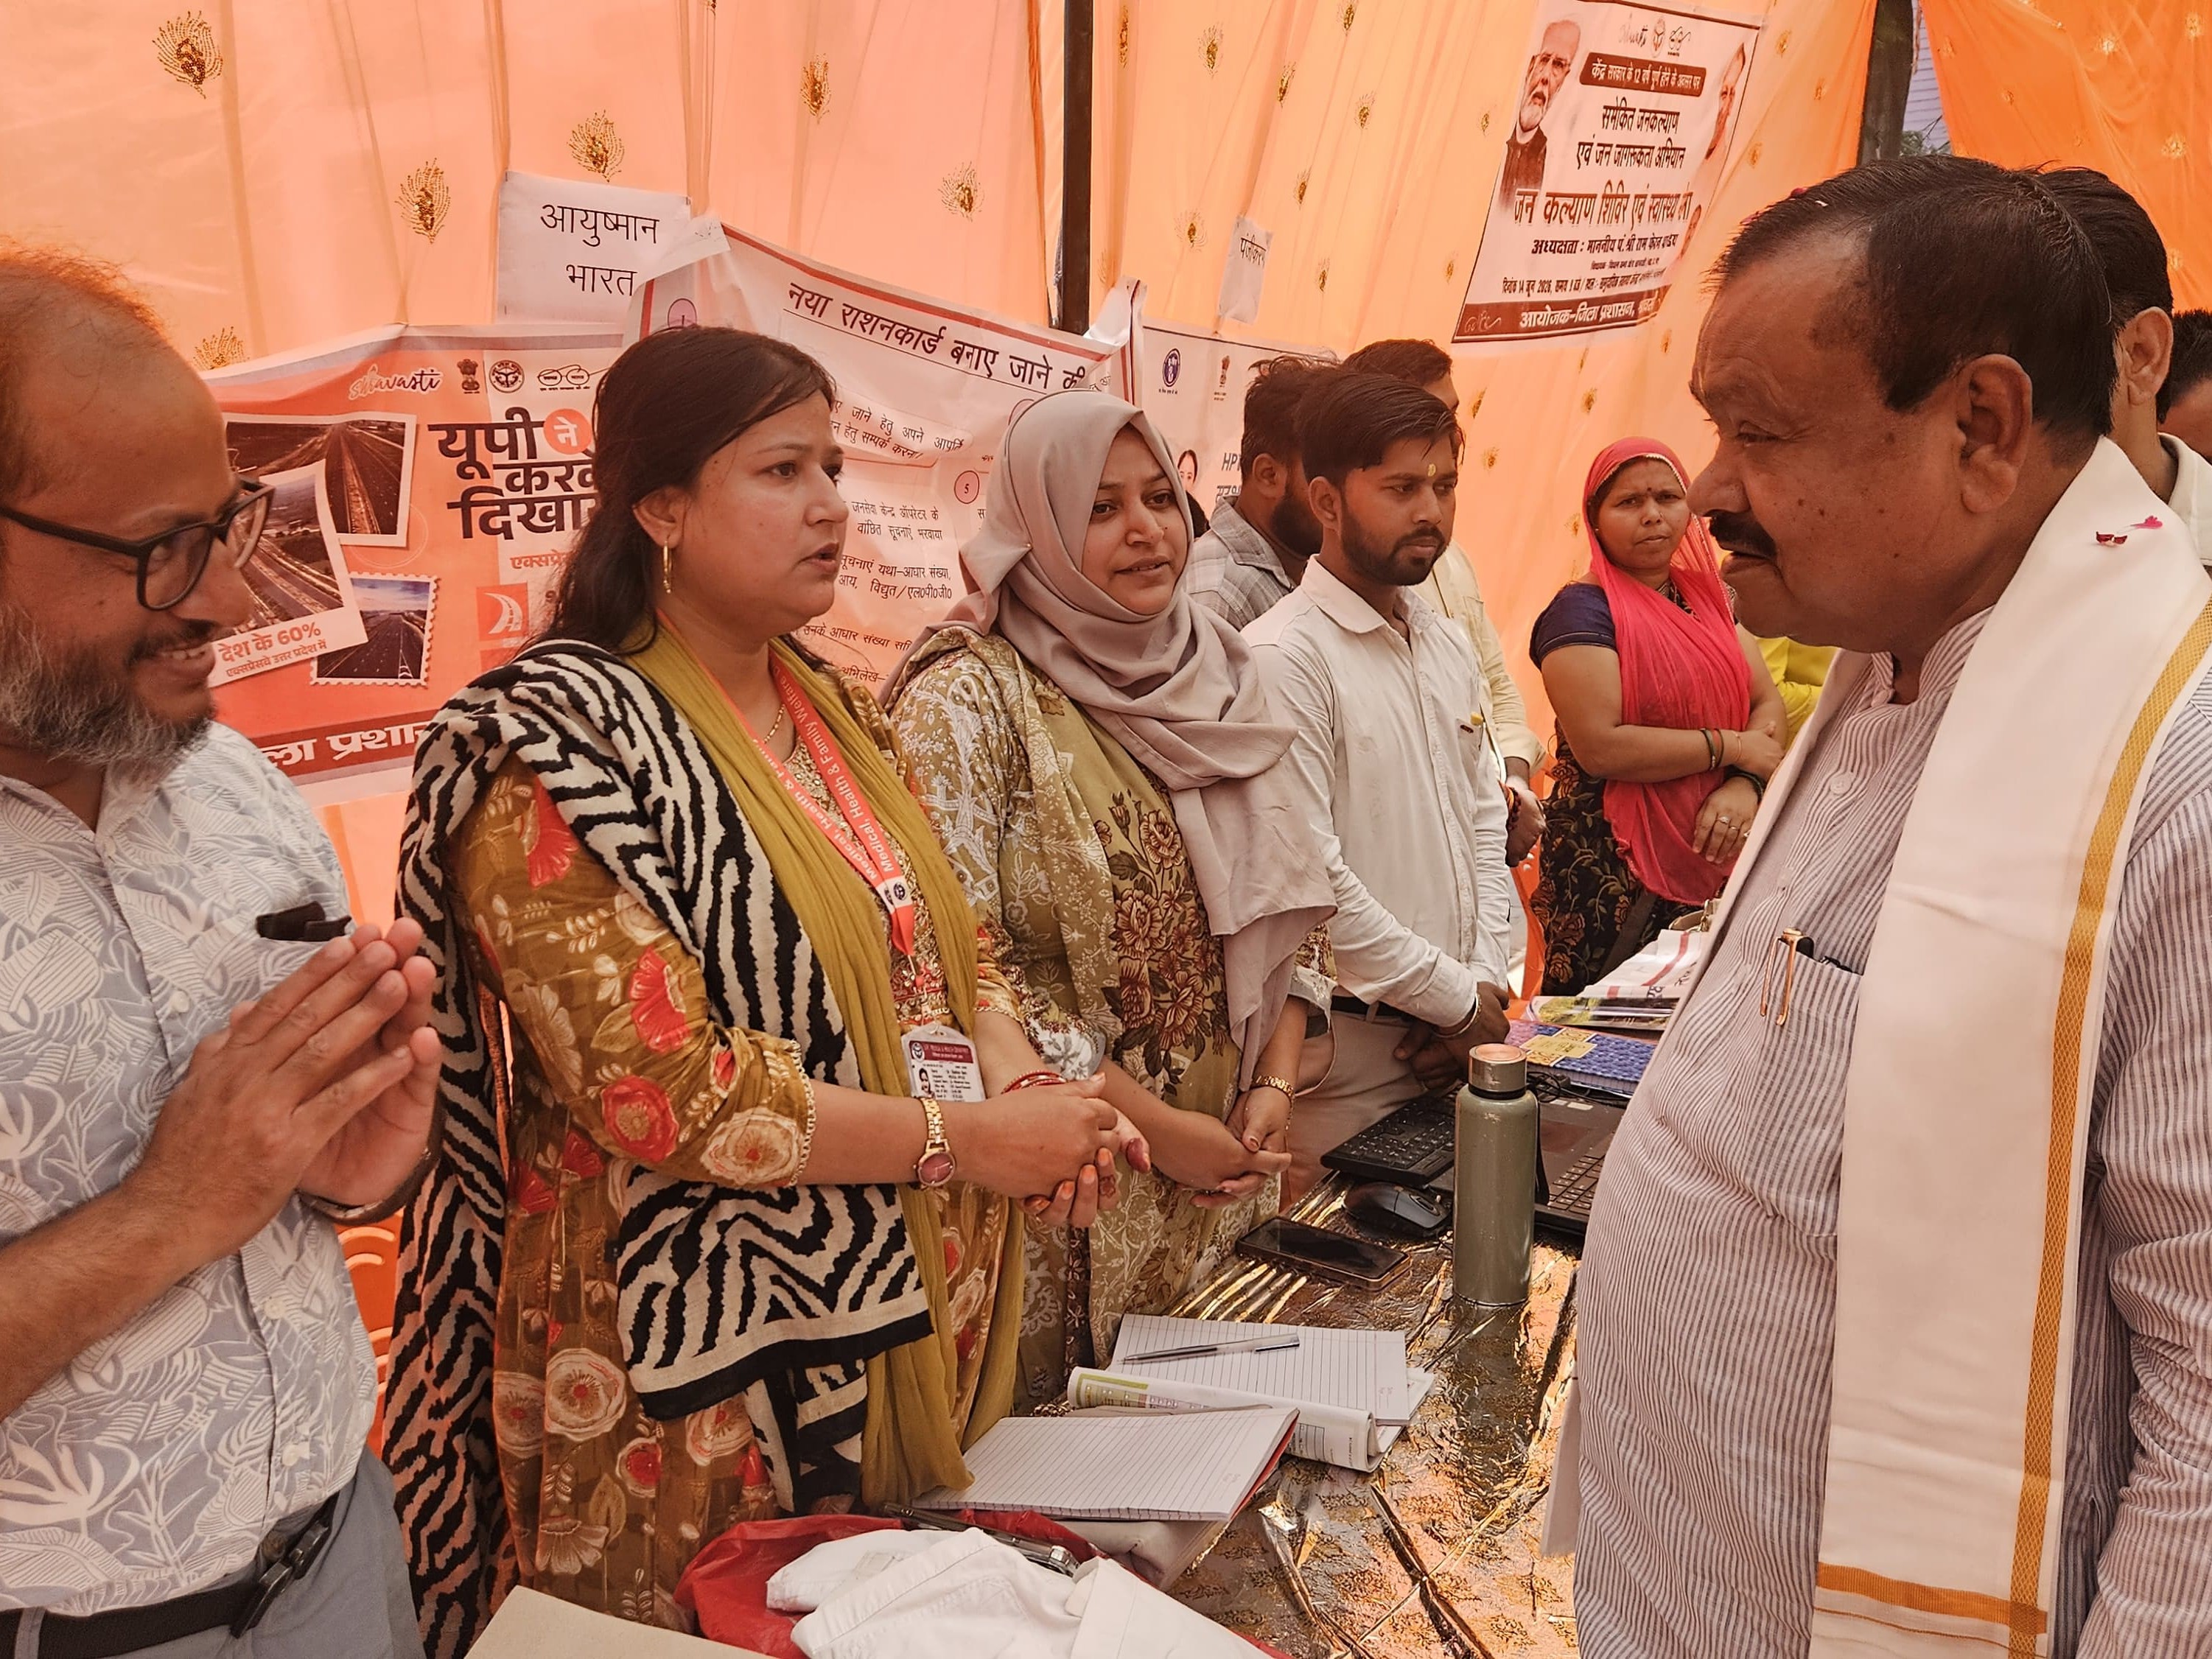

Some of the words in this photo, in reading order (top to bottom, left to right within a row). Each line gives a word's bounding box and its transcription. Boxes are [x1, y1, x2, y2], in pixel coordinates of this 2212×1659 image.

[1637, 108, 1680, 134] जनकल्याण
[1576, 133, 1596, 170] एवं
[1595, 143, 1614, 166] जन
[1655, 137, 1687, 169] अभियान
[1514, 189, 1539, 224] जन
[1543, 192, 1597, 225] कल्याण
[1597, 179, 1631, 225] शिविर
[1630, 183, 1650, 231] एवं
[539, 203, 660, 248] आयुष्मान
[1531, 239, 1579, 255] अध्यक्षता
[1586, 234, 1617, 254] माननीय
[1636, 237, 1649, 251] राम
[565, 263, 638, 297] भारत
[788, 282, 834, 318] नया
[841, 303, 948, 354] राशनकार्ड
[951, 340, 999, 378] बनाए
[1009, 354, 1054, 389] जाने
[844, 421, 858, 444] हेतु
[861, 431, 892, 449] सम्पर्क
[852, 406, 872, 423] जाने
[880, 414, 895, 437] हेतु
[902, 426, 925, 443] अपने
[427, 407, 546, 480] यूपी
[553, 415, 578, 447] ने
[964, 483, 970, 494] 5
[851, 499, 877, 516] जनसेवा
[930, 506, 939, 521] के
[857, 519, 882, 536] वांछित
[218, 639, 251, 663] देश
[251, 632, 273, 651] के
[277, 622, 322, 645] 60%
[270, 649, 293, 664] उत्तर
[293, 642, 318, 658] प्रदेश
[318, 638, 328, 650] में
[830, 627, 859, 642] आधार
[863, 634, 891, 648] संख्या
[780, 676, 809, 723] Welfare
[326, 720, 433, 761] प्रशा
[805, 721, 834, 765] Family
[784, 779, 795, 790] &
[827, 765, 840, 776] &
[794, 791, 833, 830] Health
[836, 776, 864, 818] Health
[833, 830, 878, 880] Medical,
[859, 818, 895, 873] Medical,
